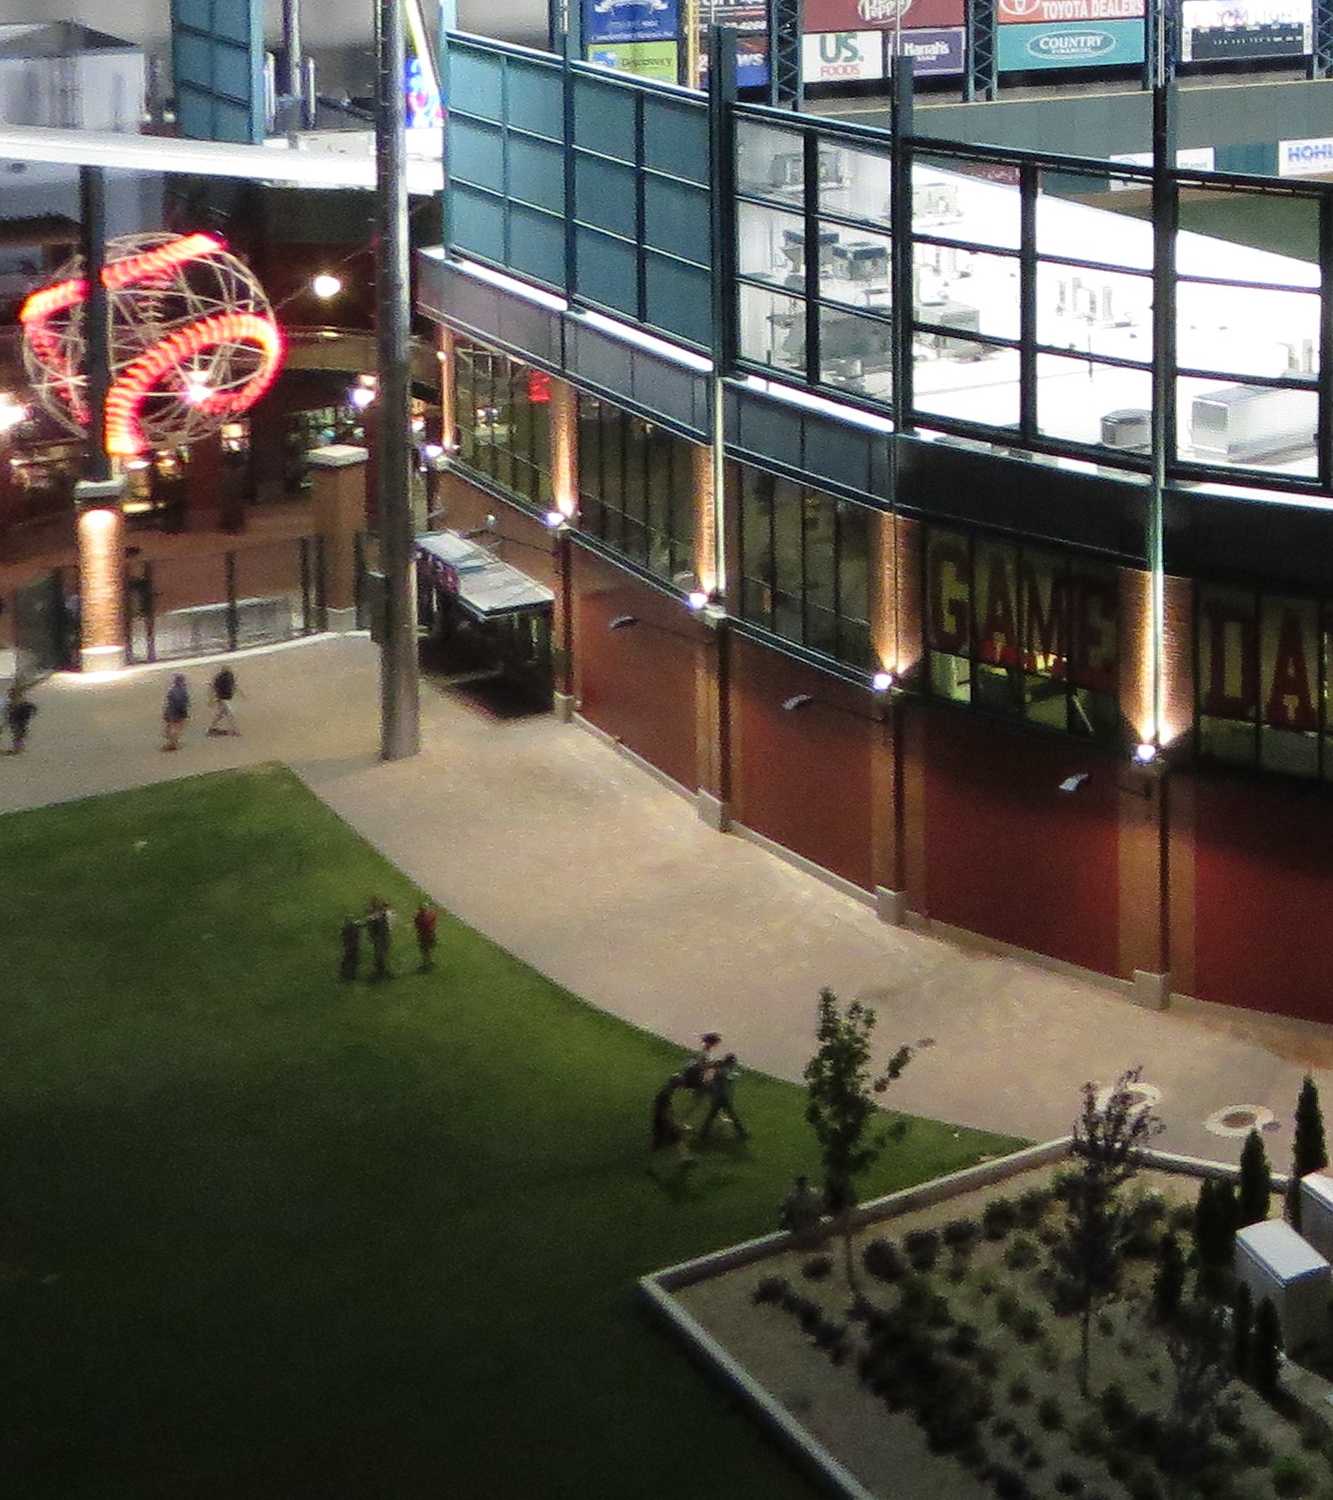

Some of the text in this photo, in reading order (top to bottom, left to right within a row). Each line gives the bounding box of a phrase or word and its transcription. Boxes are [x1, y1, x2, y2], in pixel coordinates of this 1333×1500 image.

[1042, 0, 1089, 19] TOYOTA
[1039, 36, 1104, 50] COUNTRY
[820, 64, 860, 77] FOODS
[929, 536, 1118, 690] GAME
